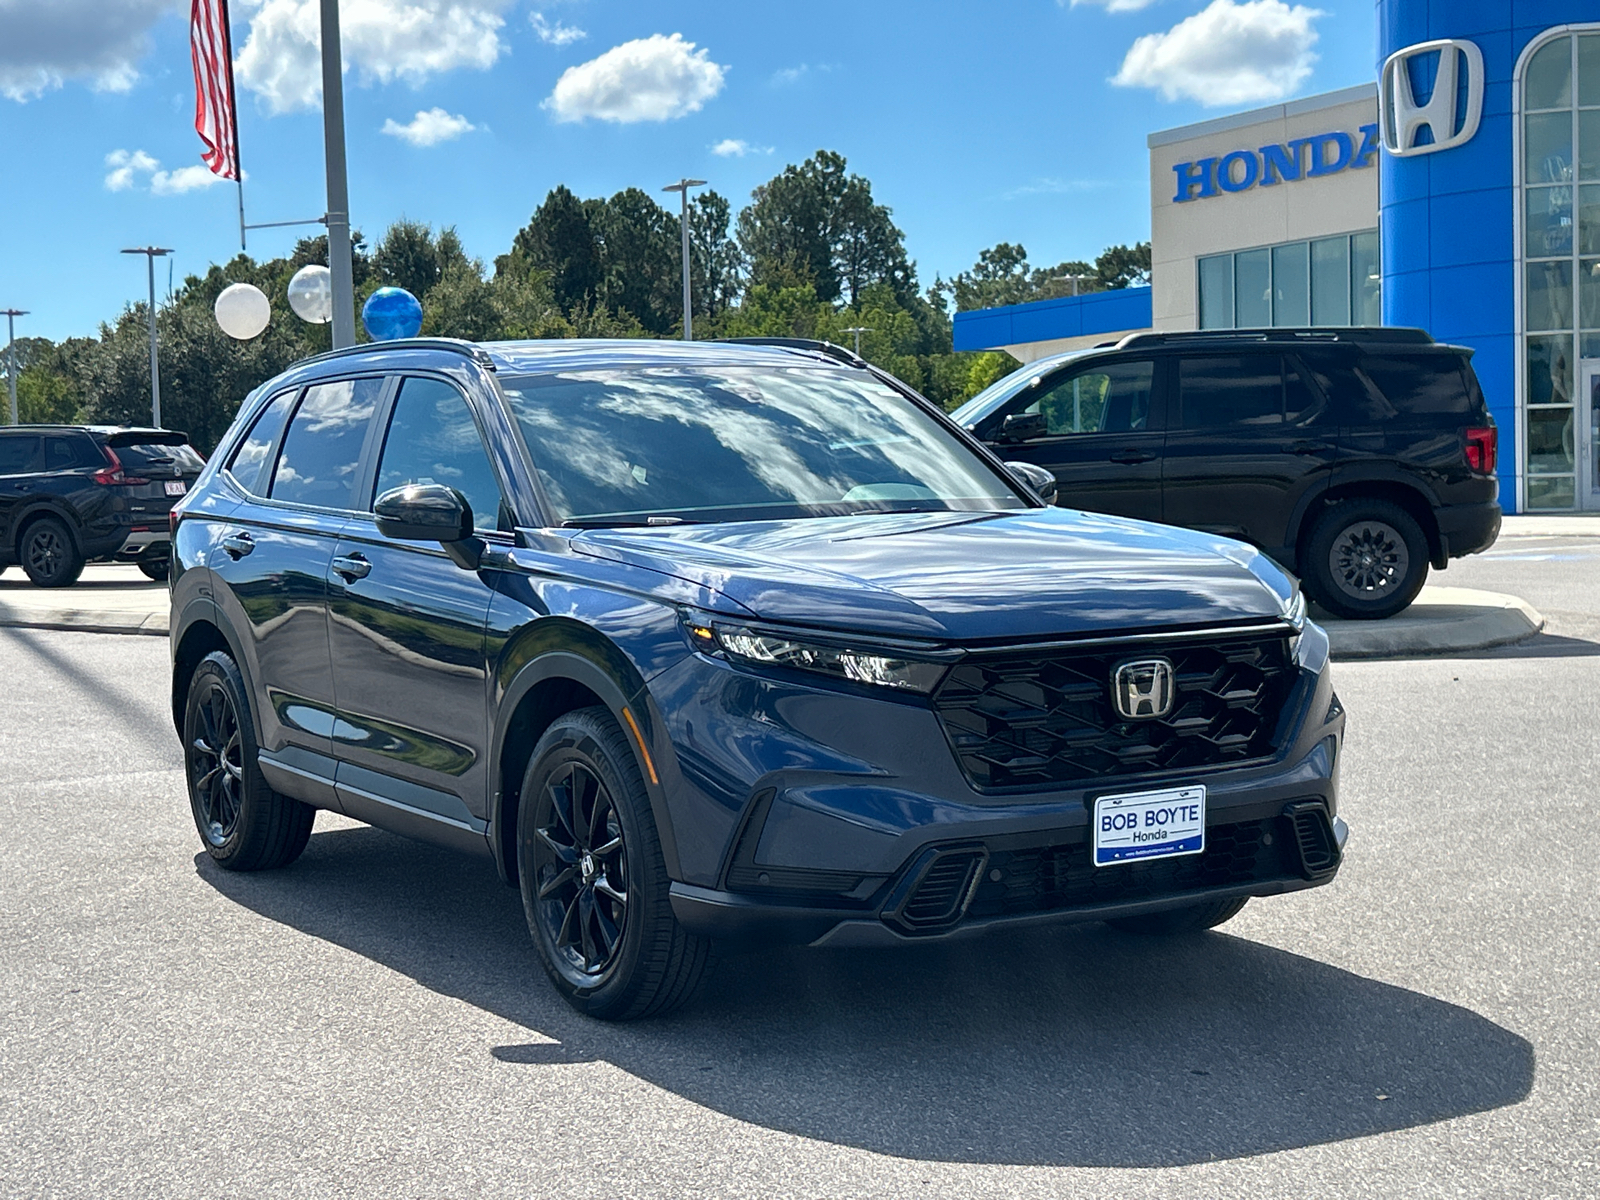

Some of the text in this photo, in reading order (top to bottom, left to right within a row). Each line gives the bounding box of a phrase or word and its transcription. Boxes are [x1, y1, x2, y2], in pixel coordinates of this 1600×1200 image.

[1172, 123, 1379, 203] HONDA
[1101, 804, 1199, 832] BOB BOYTE
[1132, 828, 1168, 843] Honda
